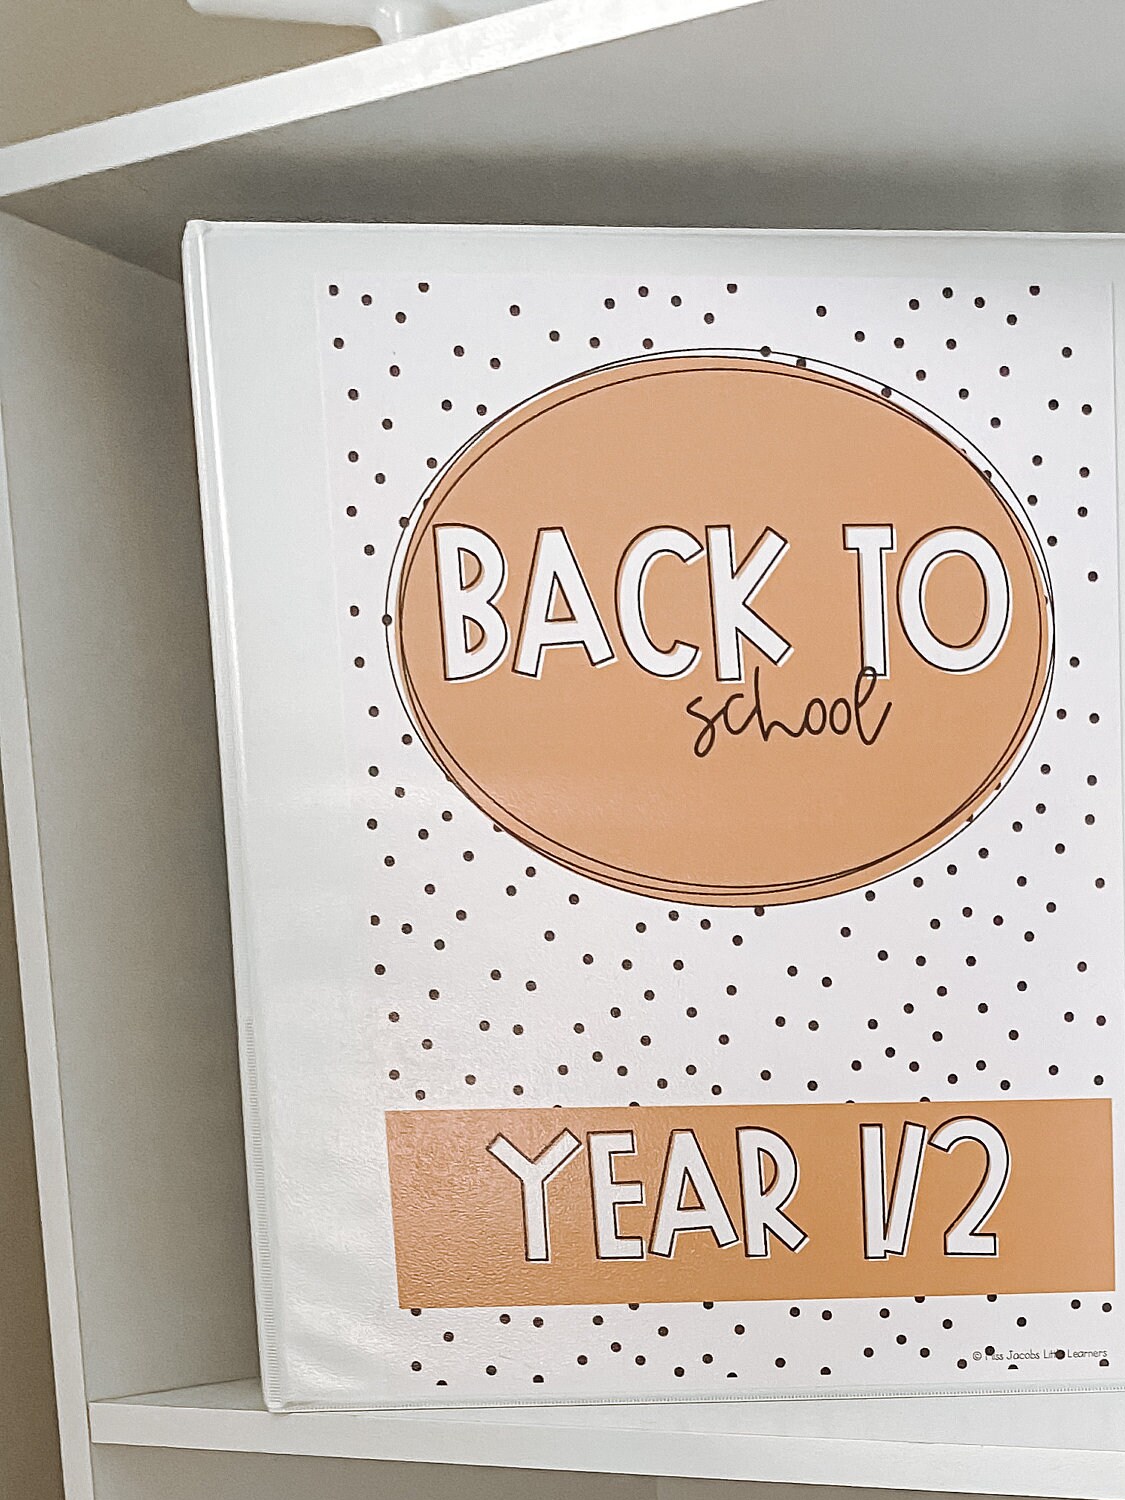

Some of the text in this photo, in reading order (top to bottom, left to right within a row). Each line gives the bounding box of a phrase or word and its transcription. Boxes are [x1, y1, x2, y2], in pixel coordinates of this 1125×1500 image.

[433, 522, 1012, 682] BACK TO
[686, 665, 893, 757] school
[486, 1115, 1012, 1262] YEAR 1/2
[1006, 1349, 1040, 1360] Jacobs
[1067, 1348, 1108, 1359] Learners
